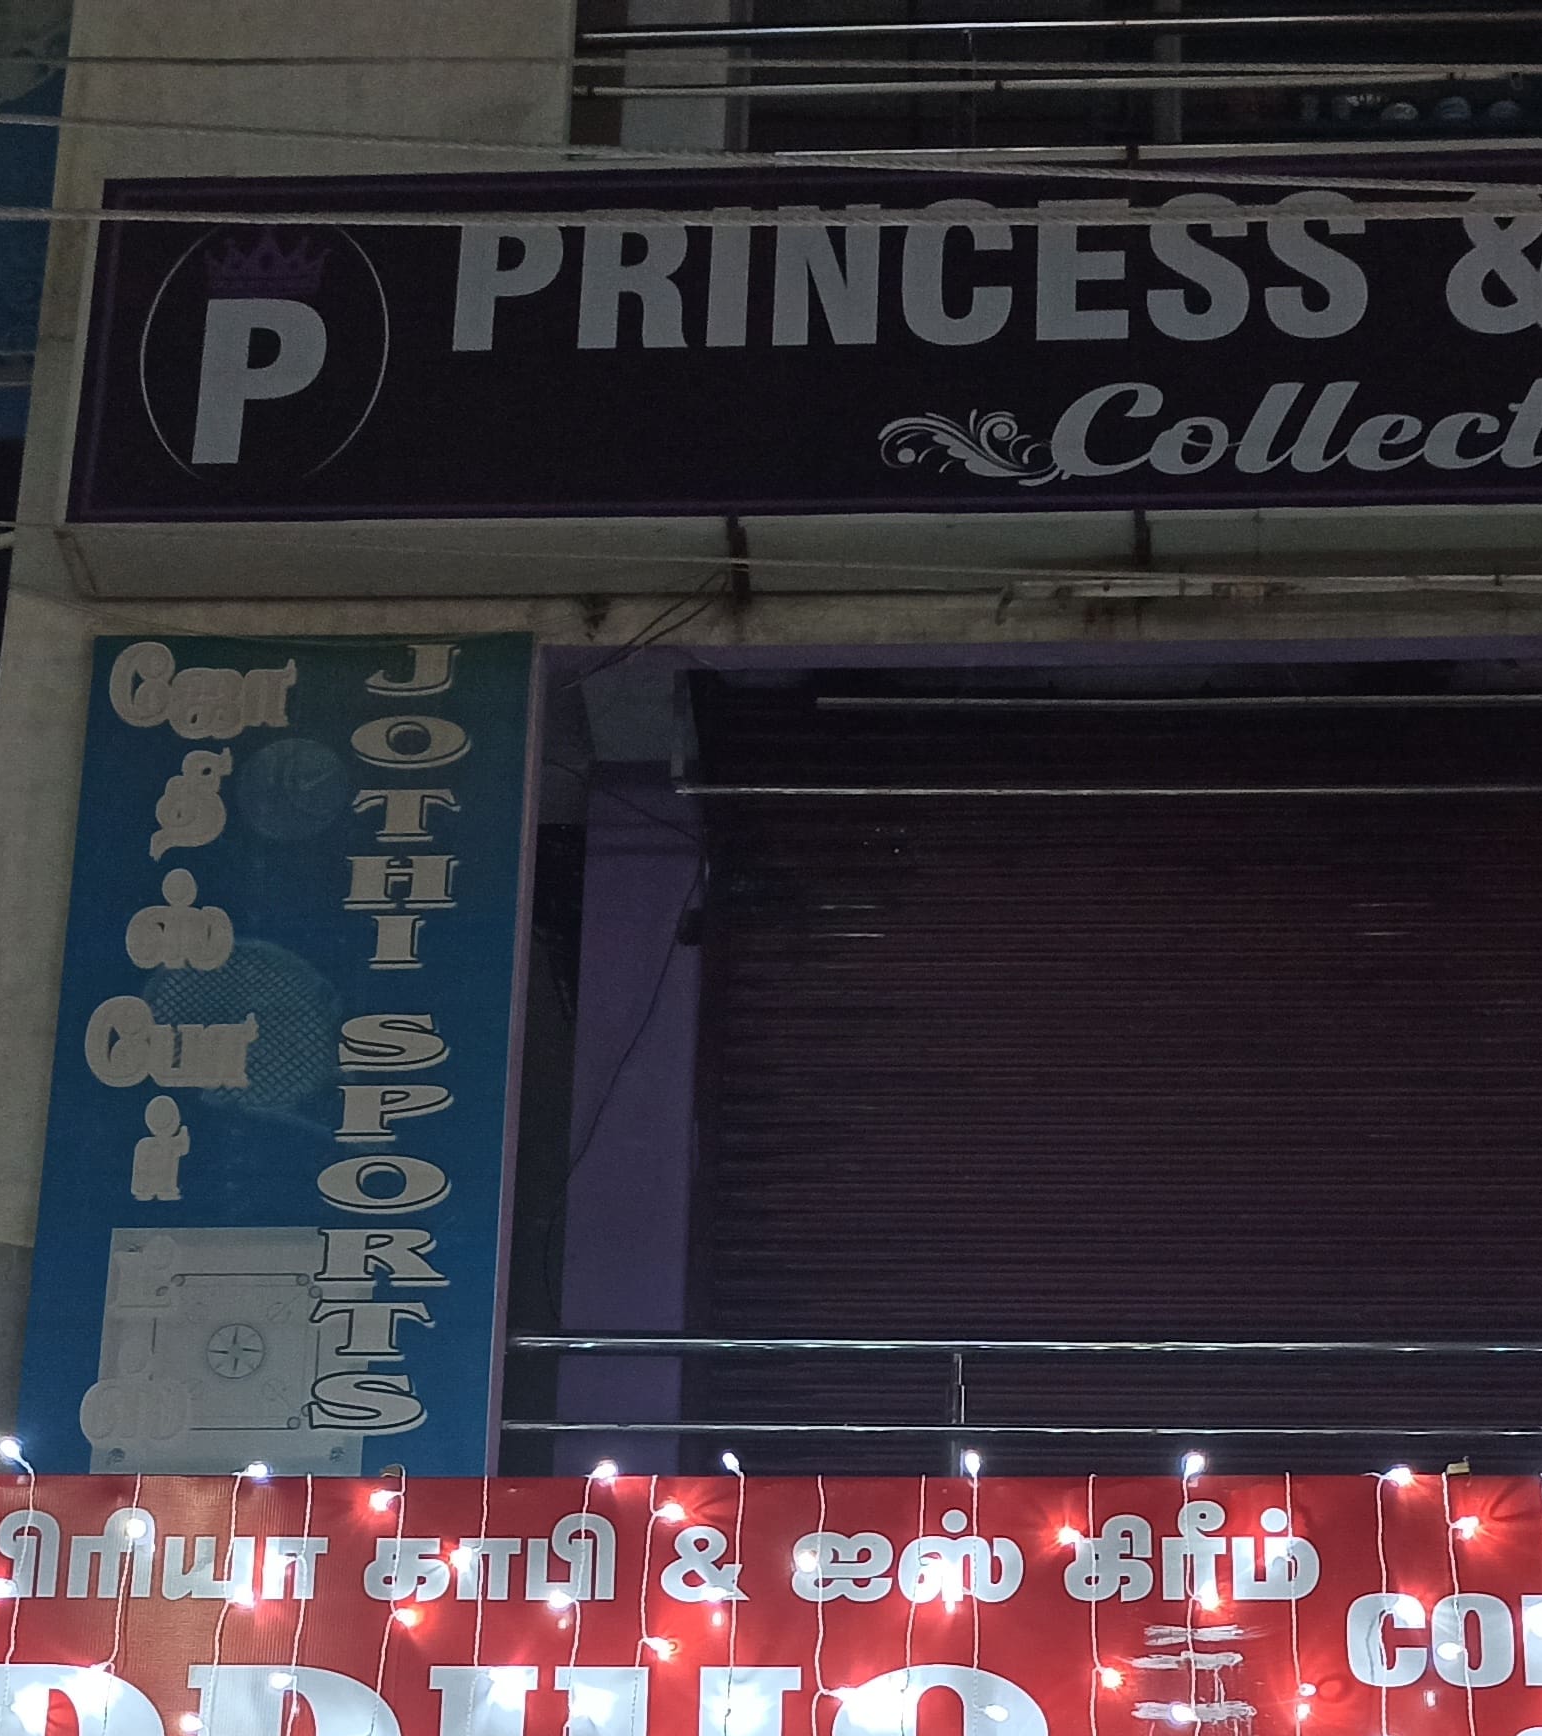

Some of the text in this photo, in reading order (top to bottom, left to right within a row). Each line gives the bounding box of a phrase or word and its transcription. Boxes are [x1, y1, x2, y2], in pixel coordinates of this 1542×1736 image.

[452, 191, 1369, 352] PRINCESS
[190, 298, 327, 464] P
[343, 643, 471, 970] JOTHI
[307, 1013, 455, 1436] SPORTS
[363, 1510, 619, 1602] காபி
[659, 1525, 750, 1603] &
[792, 1508, 1023, 1604] ஐஸ்
[1064, 1501, 1321, 1605] கிரீம்
